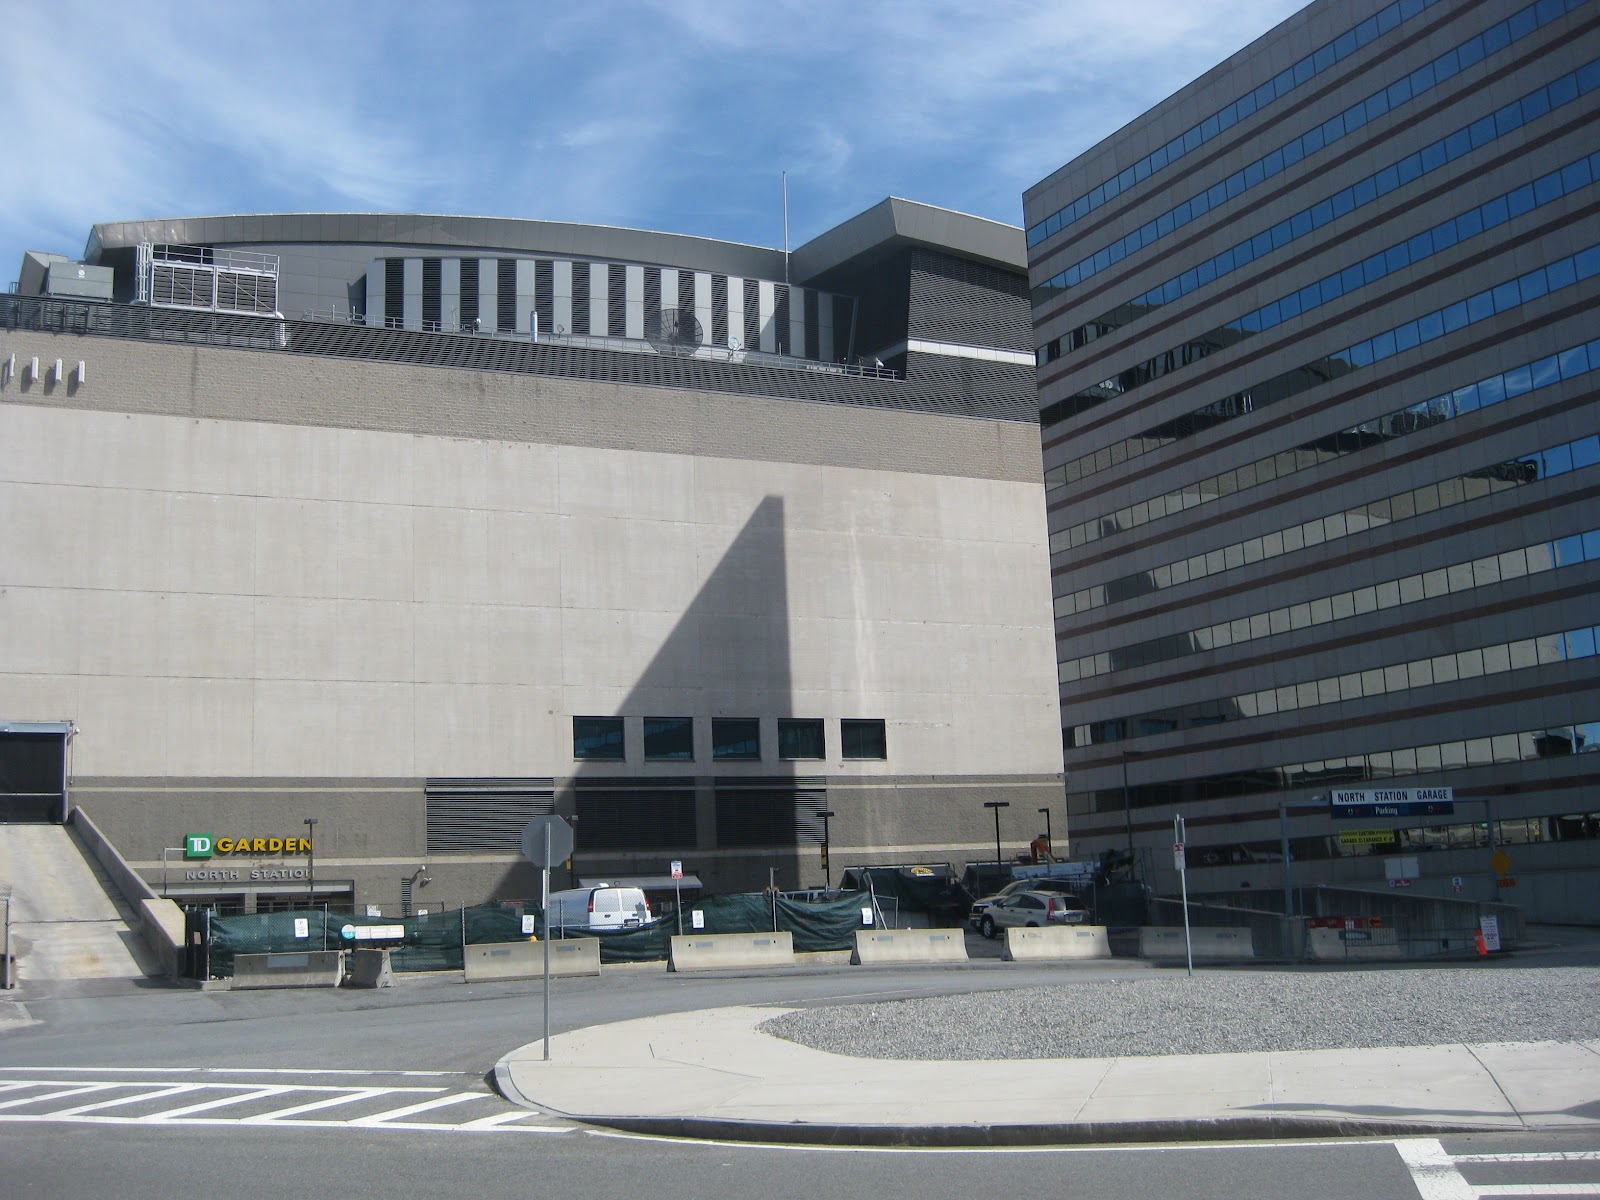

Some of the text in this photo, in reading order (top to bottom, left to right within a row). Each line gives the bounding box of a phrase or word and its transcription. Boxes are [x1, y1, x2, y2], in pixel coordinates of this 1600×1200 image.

[1338, 789, 1448, 802] NORTH STATION GARAGE
[1375, 806, 1398, 816] Parking
[190, 837, 314, 852] TD GARDEN
[186, 869, 315, 880] NORTH STATION
